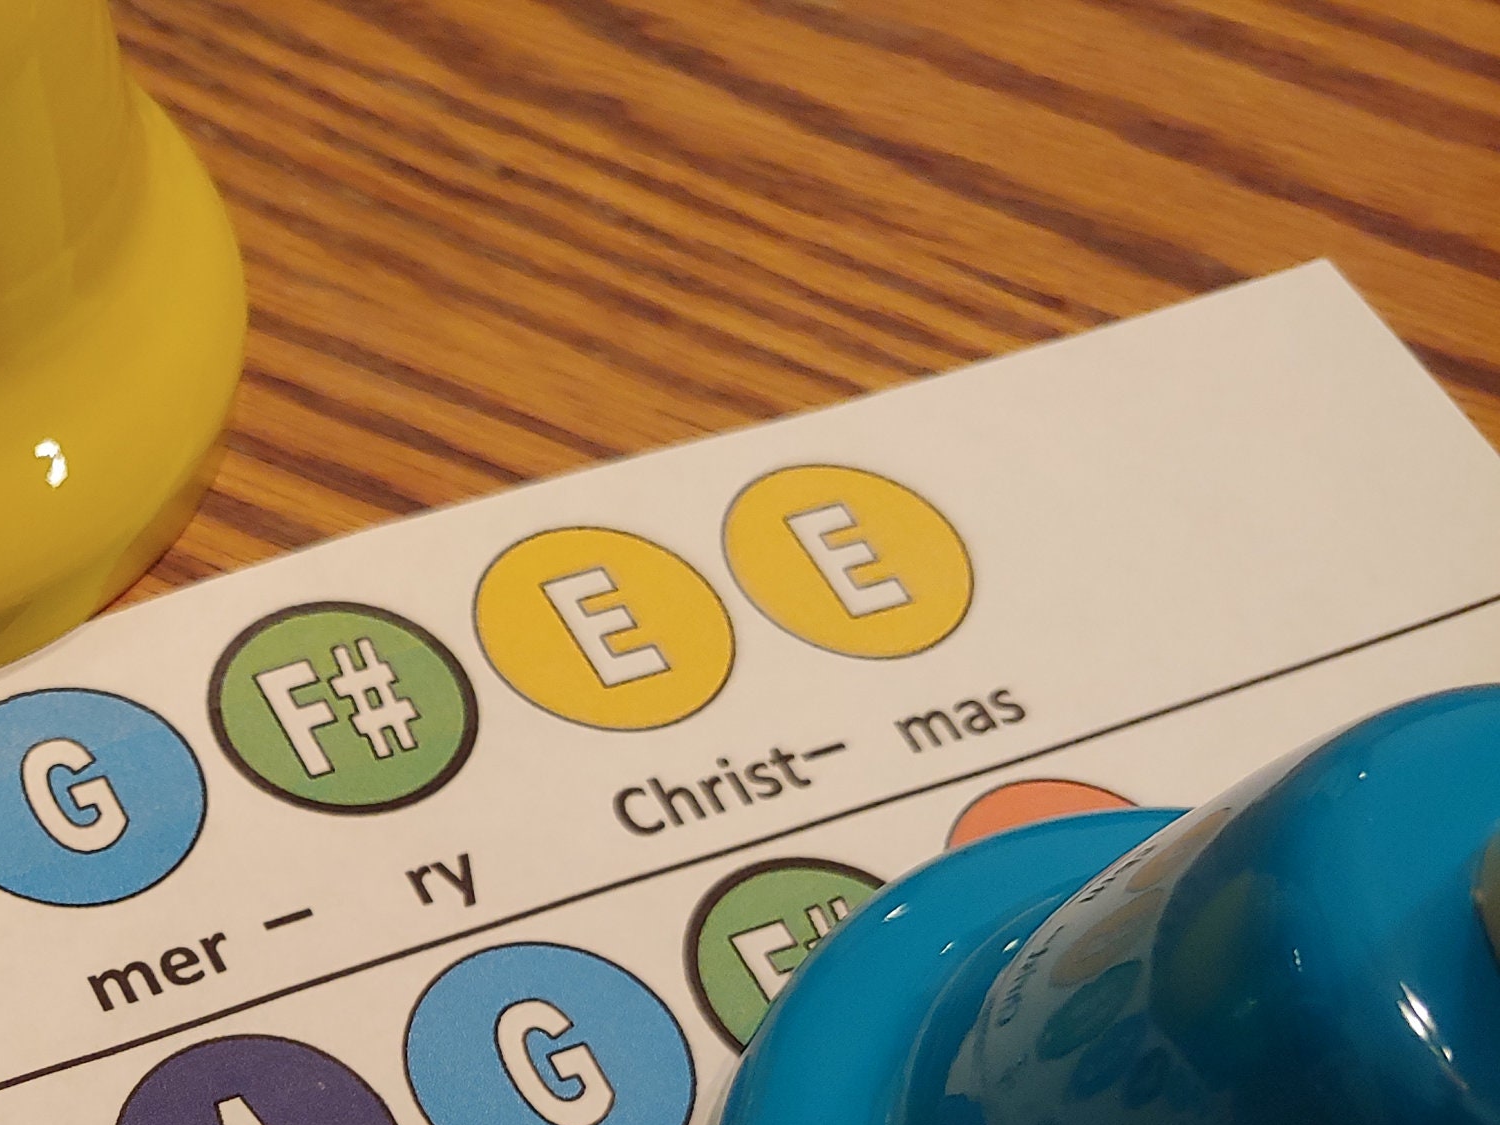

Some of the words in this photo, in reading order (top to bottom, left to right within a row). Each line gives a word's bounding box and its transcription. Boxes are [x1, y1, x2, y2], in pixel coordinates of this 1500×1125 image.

[20, 738, 130, 854] G
[253, 637, 421, 779] F#
[539, 566, 673, 689] E
[783, 502, 913, 619] E
[86, 931, 229, 1012] mer
[404, 853, 477, 906] ry
[893, 687, 1027, 754] mas
